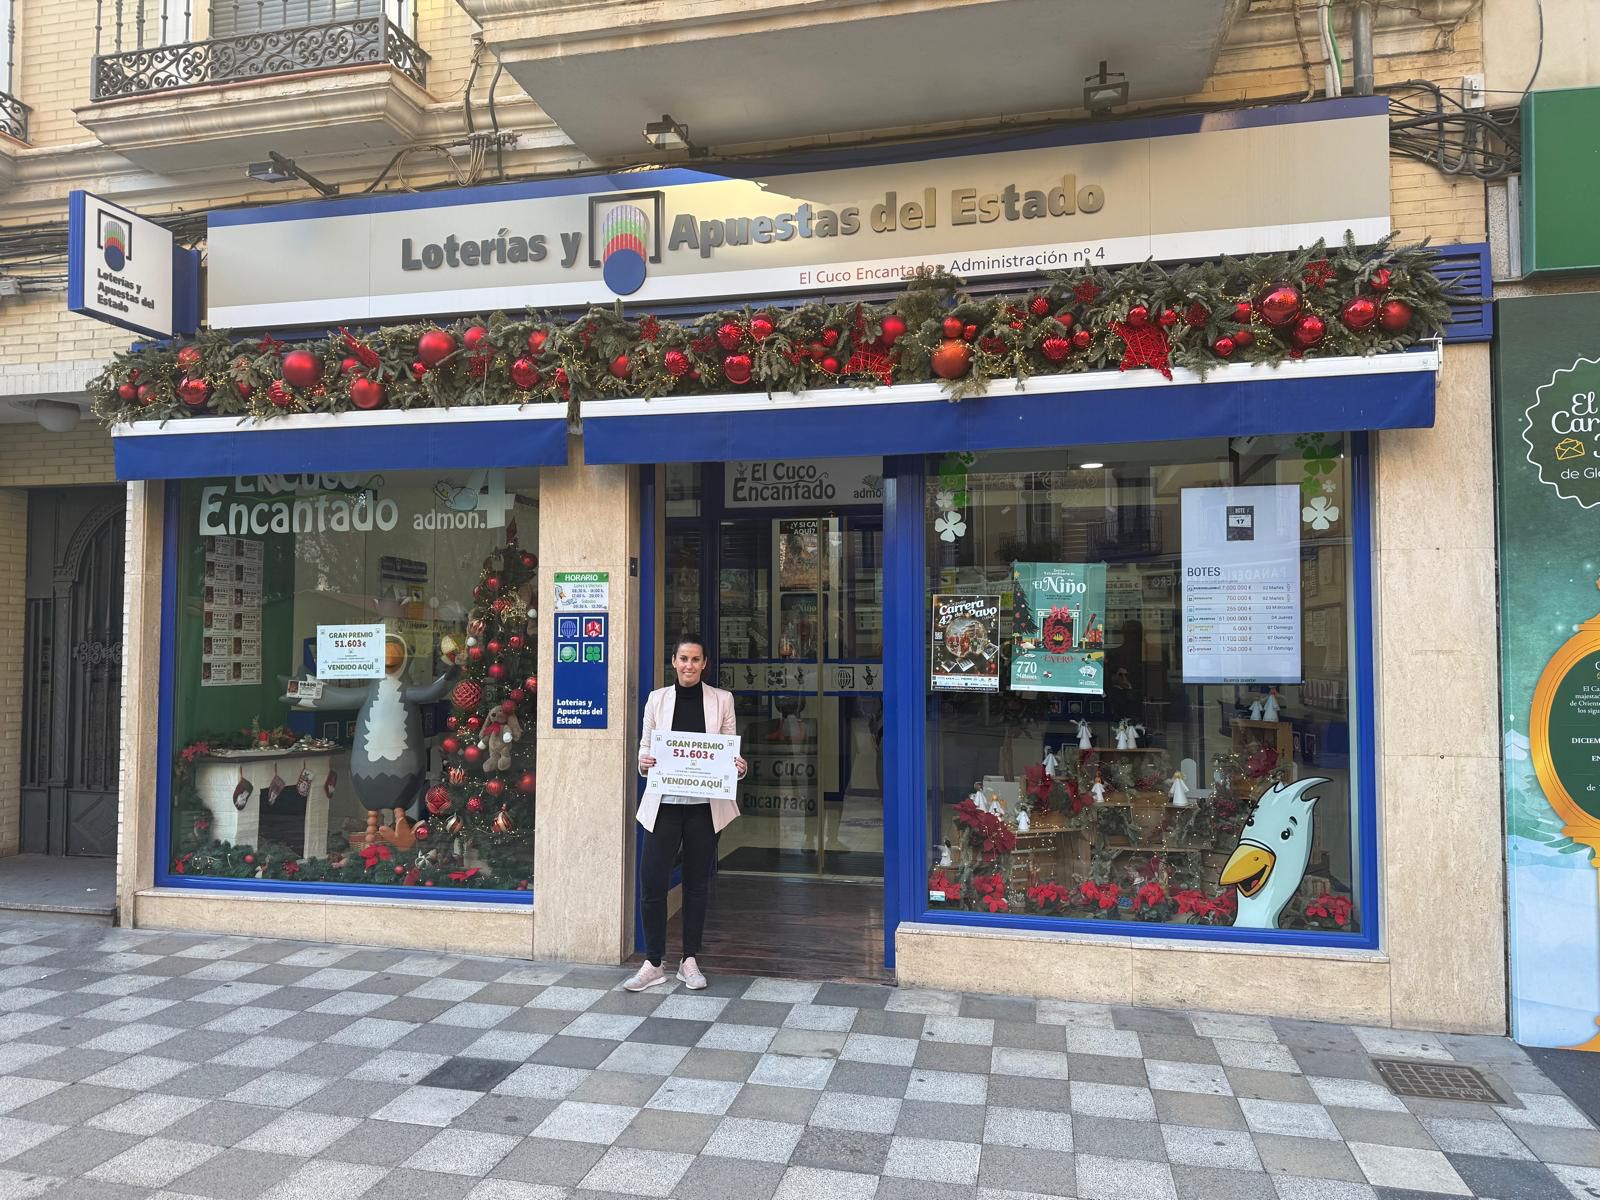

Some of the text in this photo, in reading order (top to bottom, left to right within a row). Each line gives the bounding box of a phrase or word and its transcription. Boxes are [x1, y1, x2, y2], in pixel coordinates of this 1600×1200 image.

[402, 174, 1106, 271] Loterías y Apuestas del Estado
[799, 273, 811, 285] El
[816, 270, 851, 284] Cuco
[949, 249, 1068, 273] Administración
[1094, 246, 1106, 260] 4
[97, 281, 155, 310] Apuestas del
[136, 283, 142, 295] y
[97, 294, 129, 312] Estado
[1571, 391, 1599, 417] El
[751, 462, 817, 481] El Cuco
[1560, 468, 1580, 480] de
[733, 477, 836, 502] Encantado
[199, 486, 399, 536] Encantado
[413, 508, 486, 530] admon.
[1187, 566, 1221, 577] BOTES
[1042, 576, 1087, 594] Niño
[939, 599, 985, 616] Carrera
[968, 606, 998, 618] Pavo
[938, 614, 953, 626] 42
[348, 631, 374, 639] PREMIO
[357, 662, 374, 671] AQUÍ
[1015, 661, 1038, 674] 770
[587, 699, 593, 708] y
[556, 707, 603, 716] Apuestas del
[556, 716, 582, 725] Estado
[666, 739, 724, 751] GRAN PREMIO
[661, 776, 723, 789] VENDIDO AQUÍ
[1586, 784, 1596, 792] de
